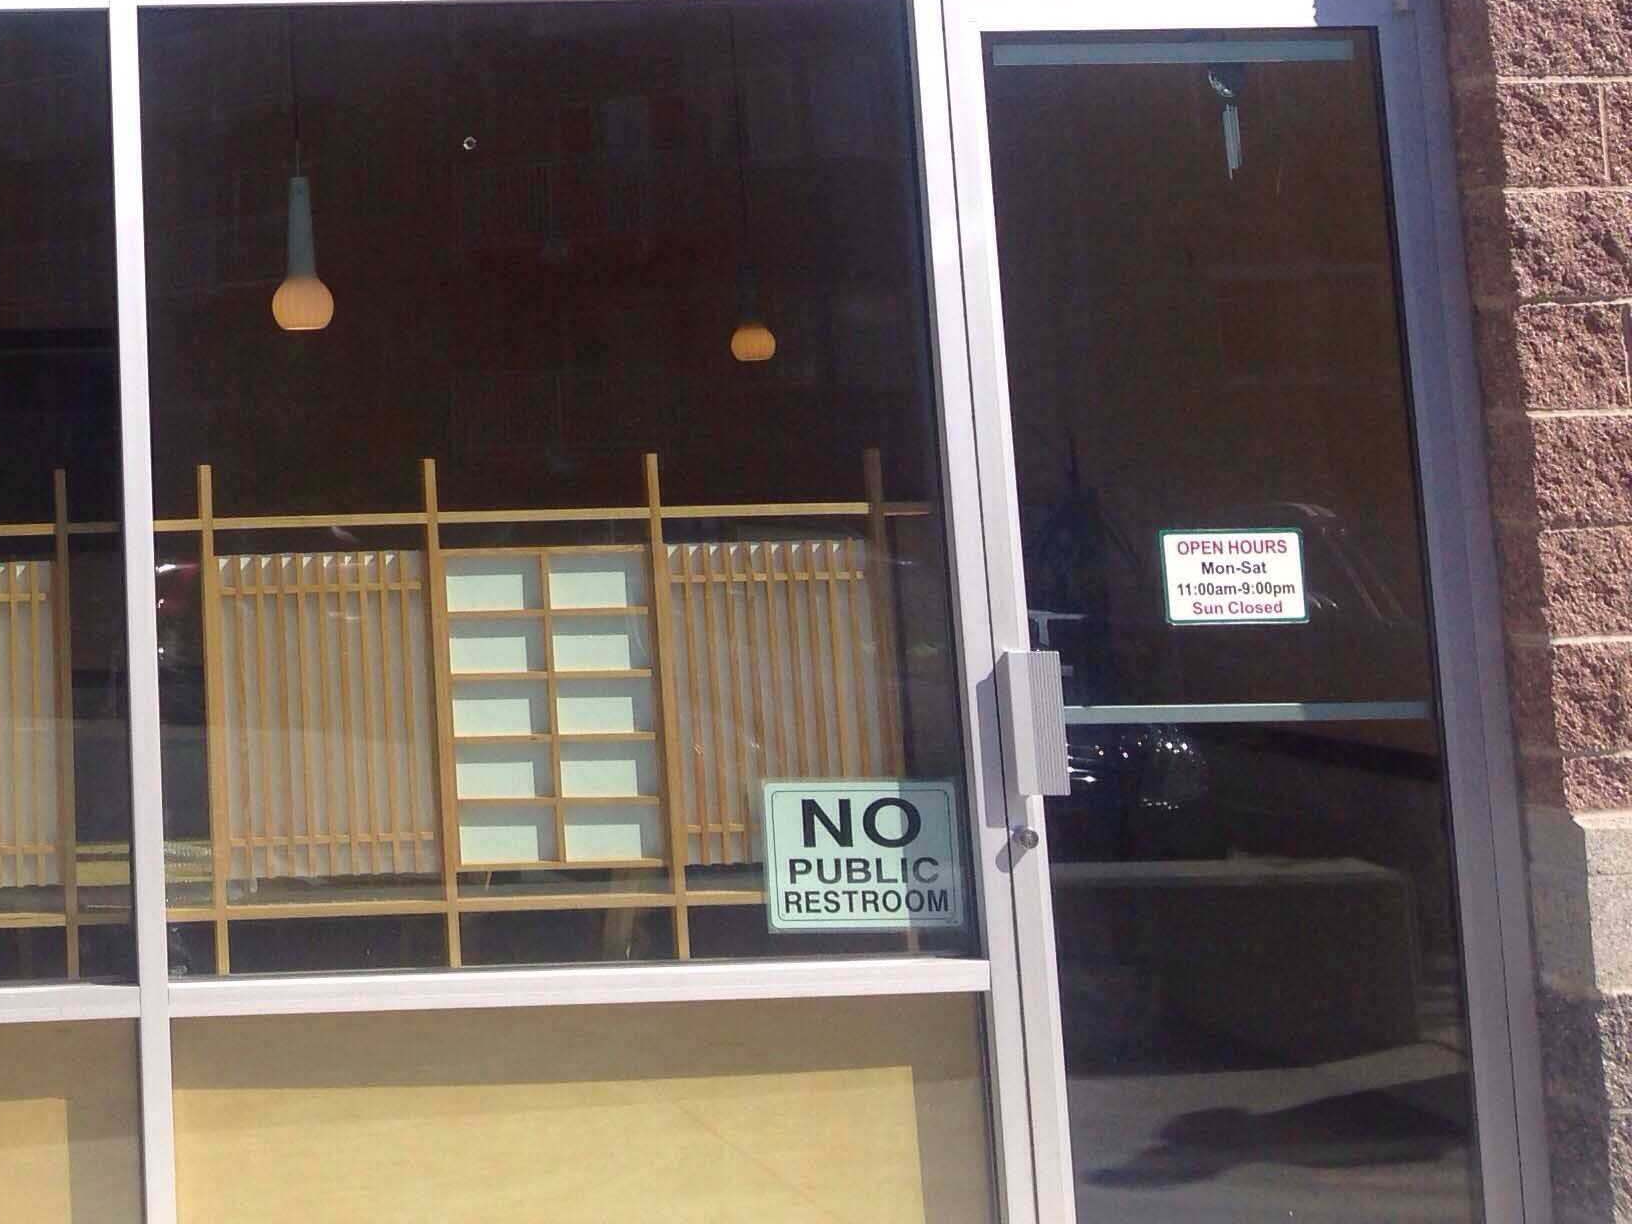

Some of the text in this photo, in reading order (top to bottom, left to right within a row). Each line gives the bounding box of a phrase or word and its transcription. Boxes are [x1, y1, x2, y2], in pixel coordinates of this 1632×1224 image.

[1177, 539, 1288, 555] OPEN HOURS
[1201, 561, 1267, 575] Mon-Sat
[1177, 582, 1296, 597] 11:00am-9:00pm
[1193, 601, 1283, 615] Sun Closed
[801, 797, 922, 848] NO
[788, 857, 940, 885] PUBLIC
[784, 889, 949, 914] RESTROOM
